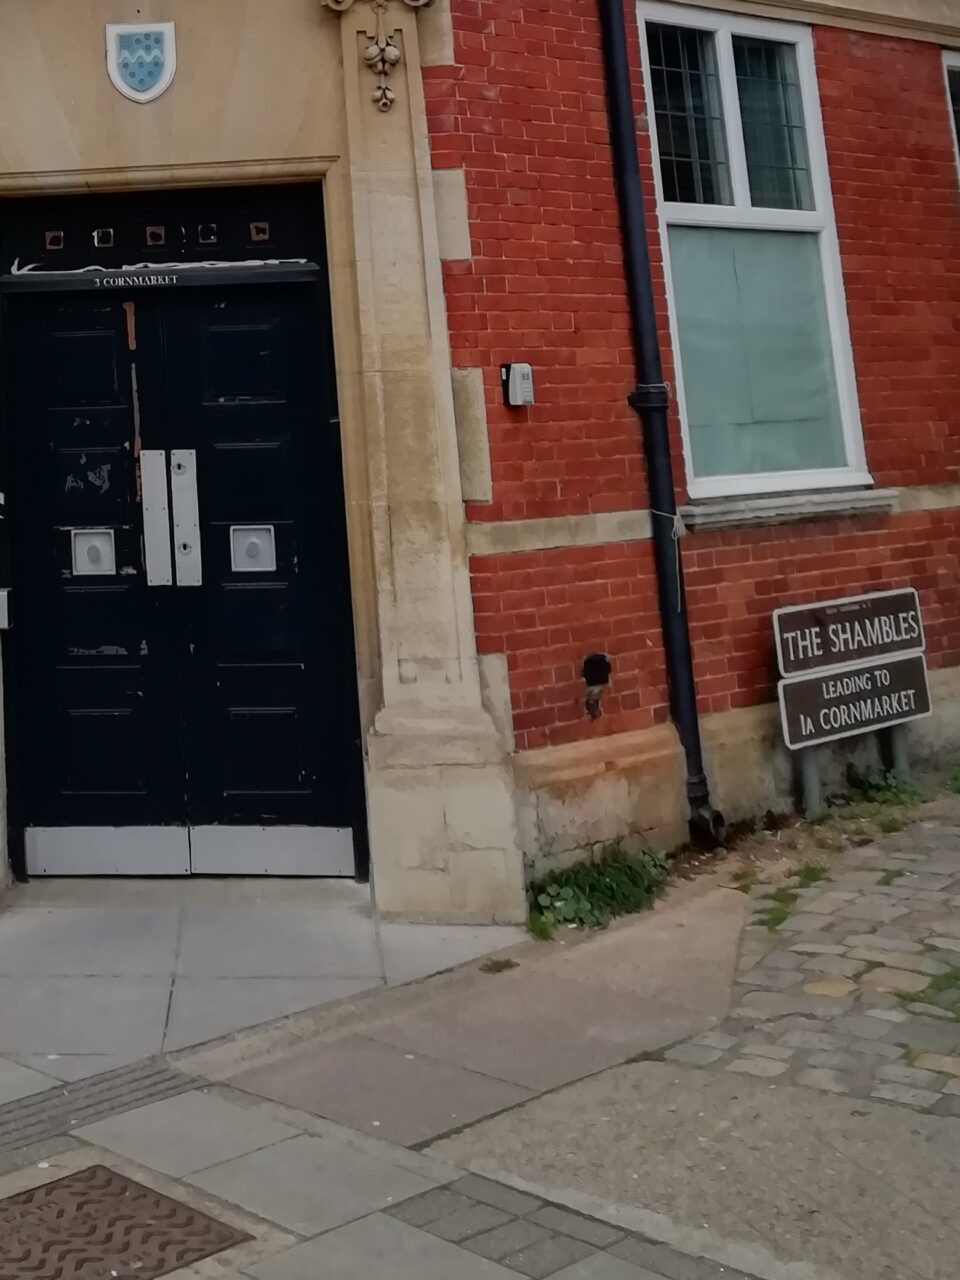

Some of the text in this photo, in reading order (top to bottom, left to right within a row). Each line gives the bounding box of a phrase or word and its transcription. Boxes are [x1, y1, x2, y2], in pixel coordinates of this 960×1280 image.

[94, 275, 179, 287] 3 CORNMARKET
[783, 610, 919, 660] THE SHAMBLES
[822, 669, 891, 700] LEADING TO
[819, 689, 916, 730] CORNMARKET
